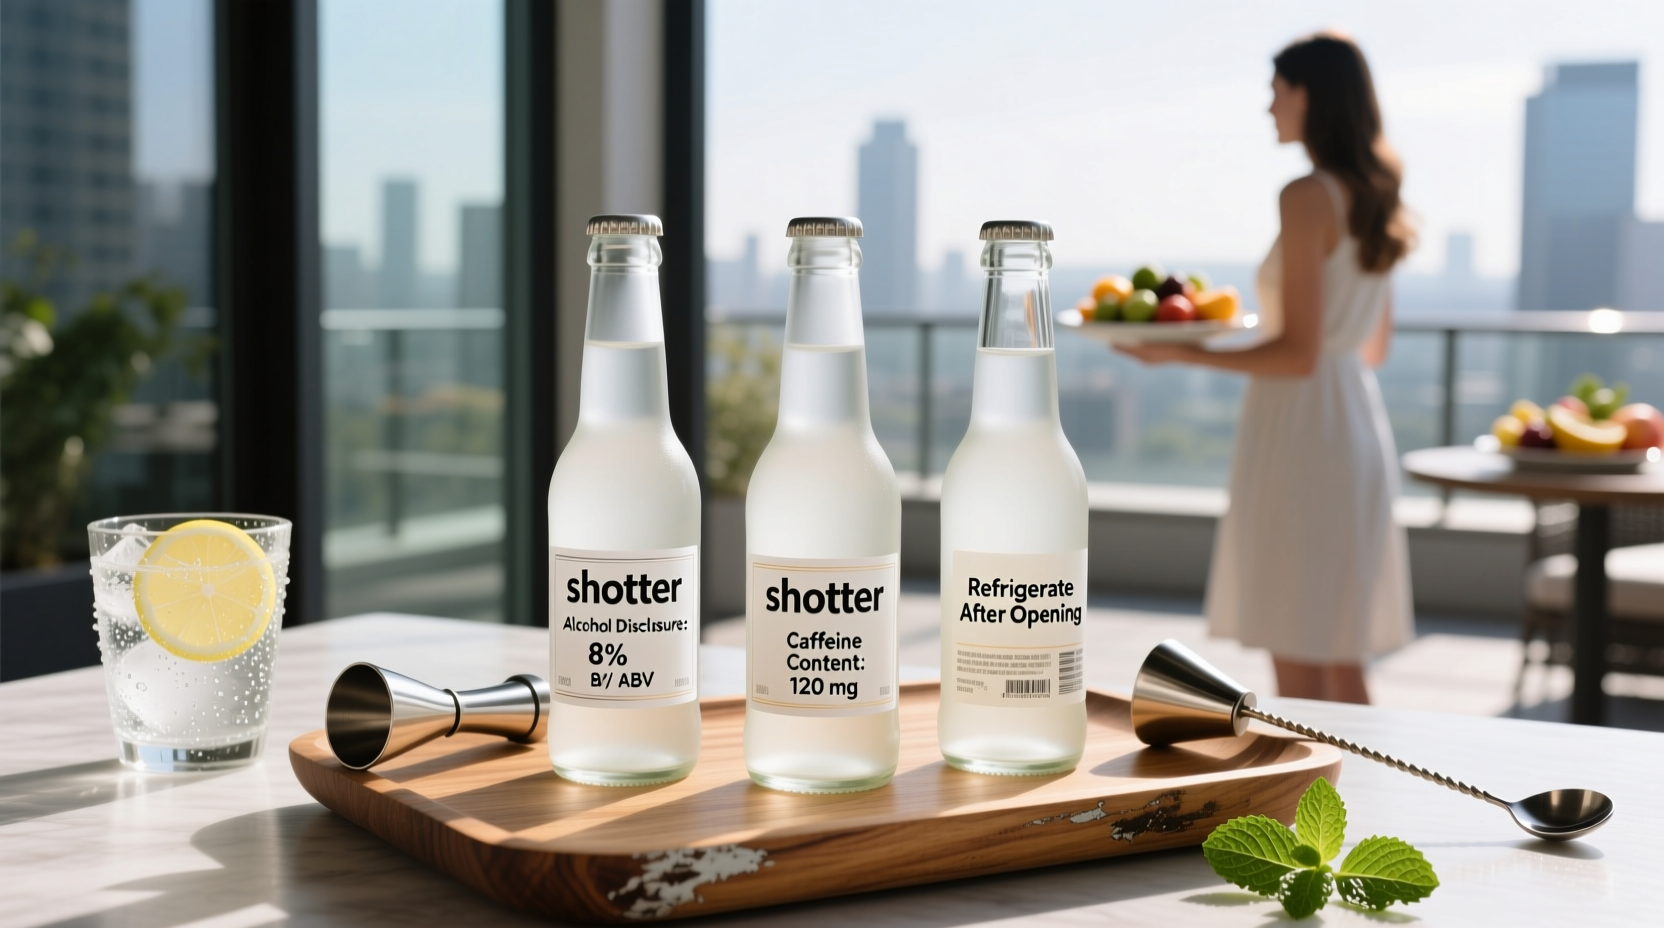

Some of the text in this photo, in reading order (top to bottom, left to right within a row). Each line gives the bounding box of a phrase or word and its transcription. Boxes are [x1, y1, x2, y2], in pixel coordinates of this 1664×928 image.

[566, 568, 683, 605] shotter
[765, 577, 885, 615] shotter
[968, 577, 1074, 603] Refrigerate
[562, 616, 612, 633] Alcohol
[959, 602, 1082, 630] After Opening
[786, 630, 863, 650] Caffeine
[588, 641, 628, 667] 8%
[786, 653, 865, 672] Content:
[617, 671, 655, 688] ABV
[789, 676, 825, 696] 120
[829, 681, 858, 701] mg
